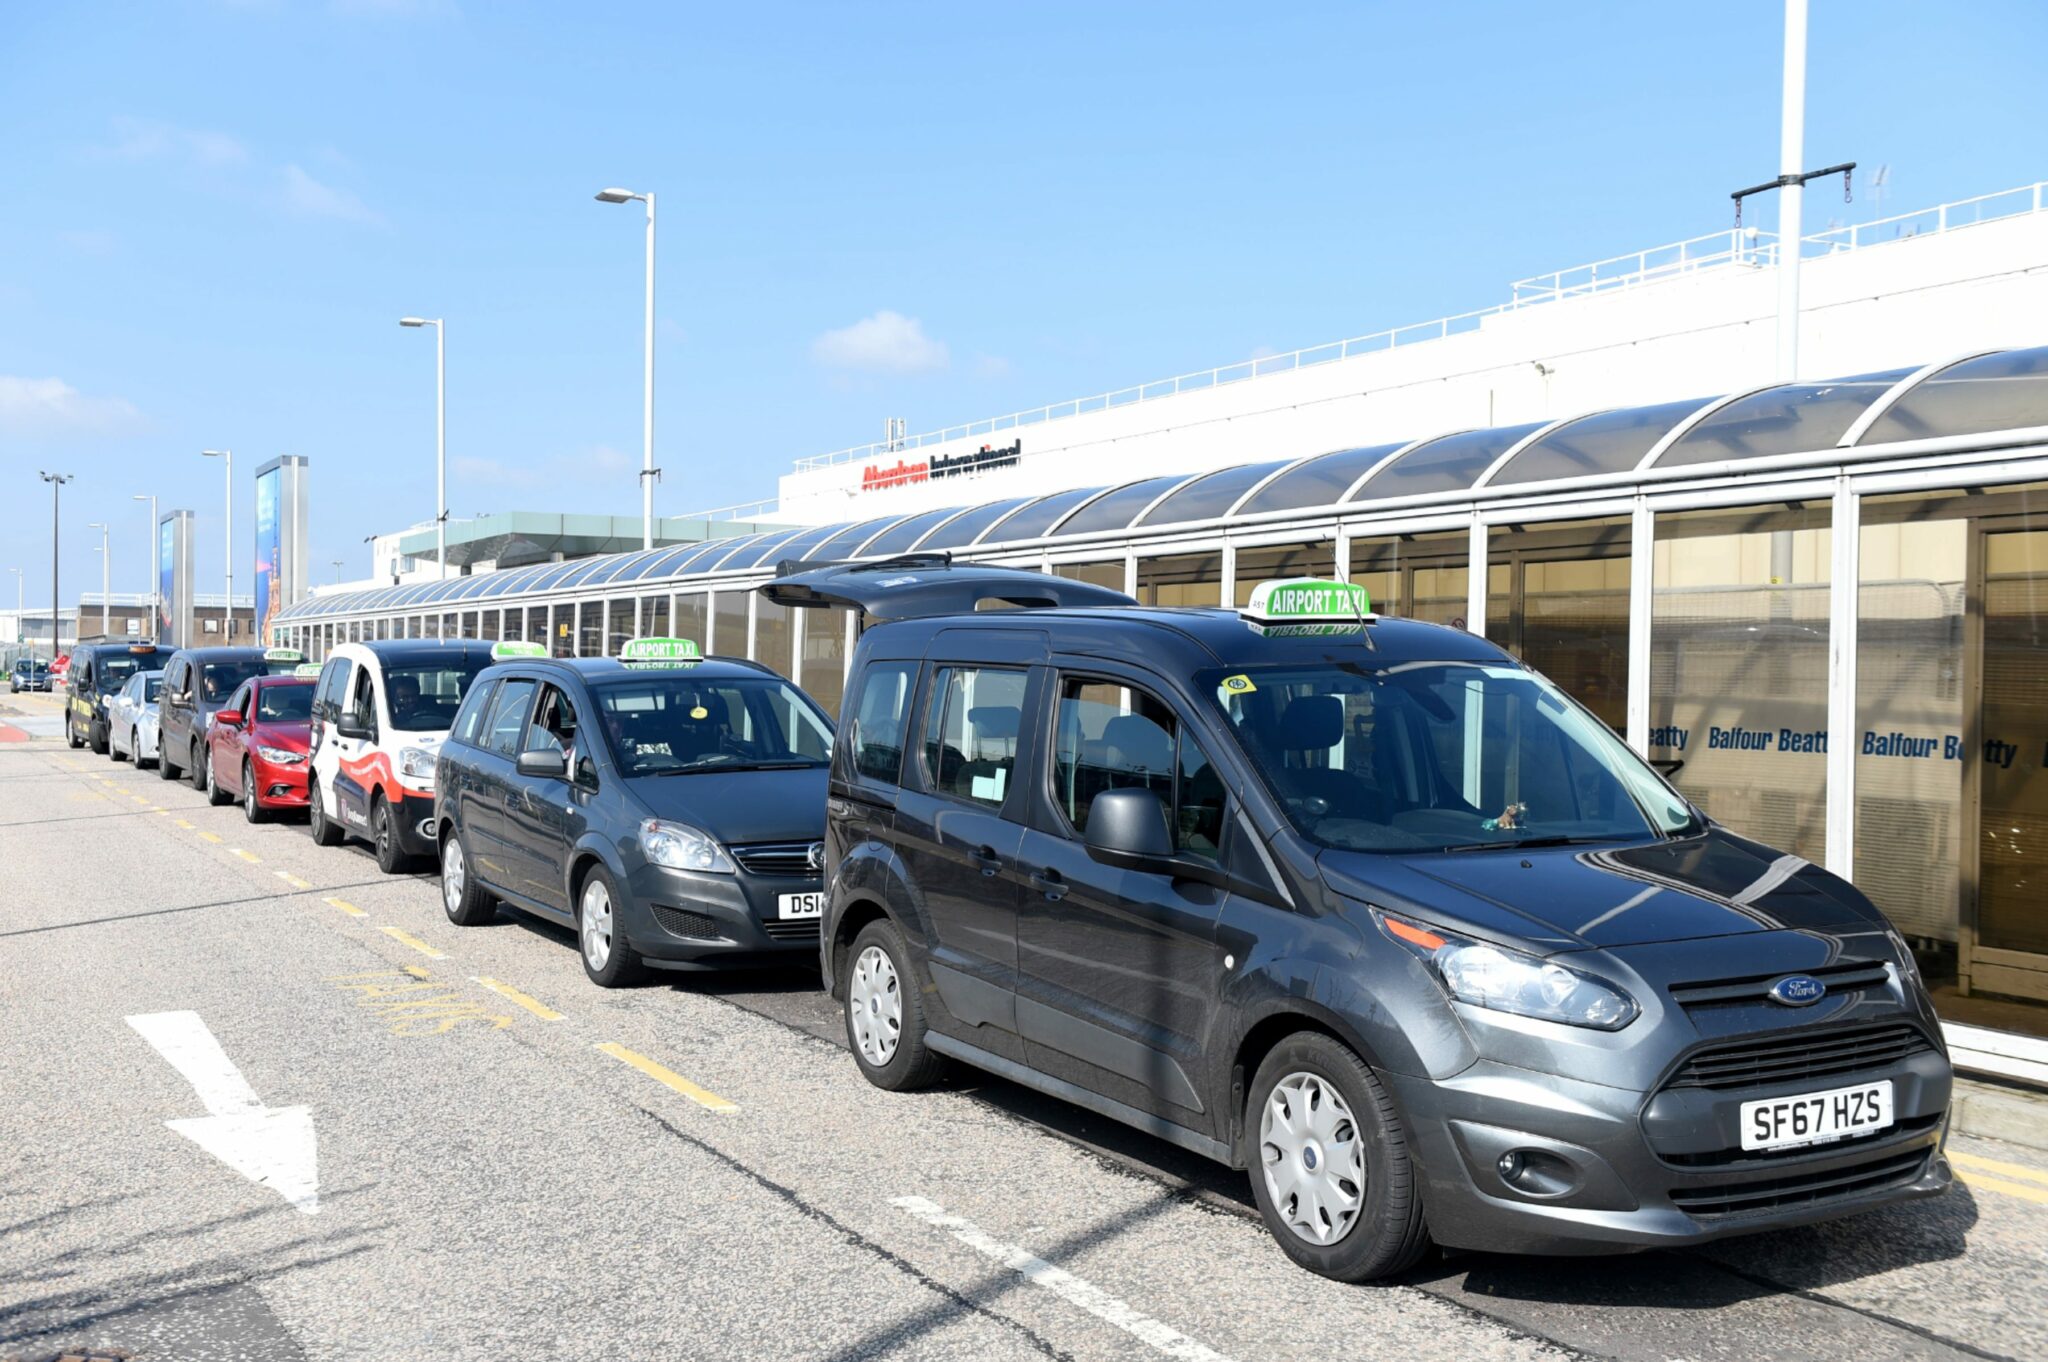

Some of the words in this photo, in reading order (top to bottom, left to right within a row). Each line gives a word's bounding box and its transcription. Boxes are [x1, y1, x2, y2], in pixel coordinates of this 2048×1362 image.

[861, 459, 929, 491] Aberdeen
[930, 438, 1022, 480] International
[1271, 589, 1332, 613] AIRPORT
[1335, 589, 1366, 613] TAXI
[630, 642, 672, 657] AIRPORT
[673, 642, 695, 657] TAXI
[1649, 726, 1689, 751] eatty
[1708, 727, 1773, 751] Balfour
[1777, 728, 1828, 754] Beatt
[1861, 731, 1939, 759] Balfour
[1788, 980, 1818, 997] Ford
[1754, 1098, 1826, 1141] SF67
[1834, 1089, 1881, 1130] HZS
